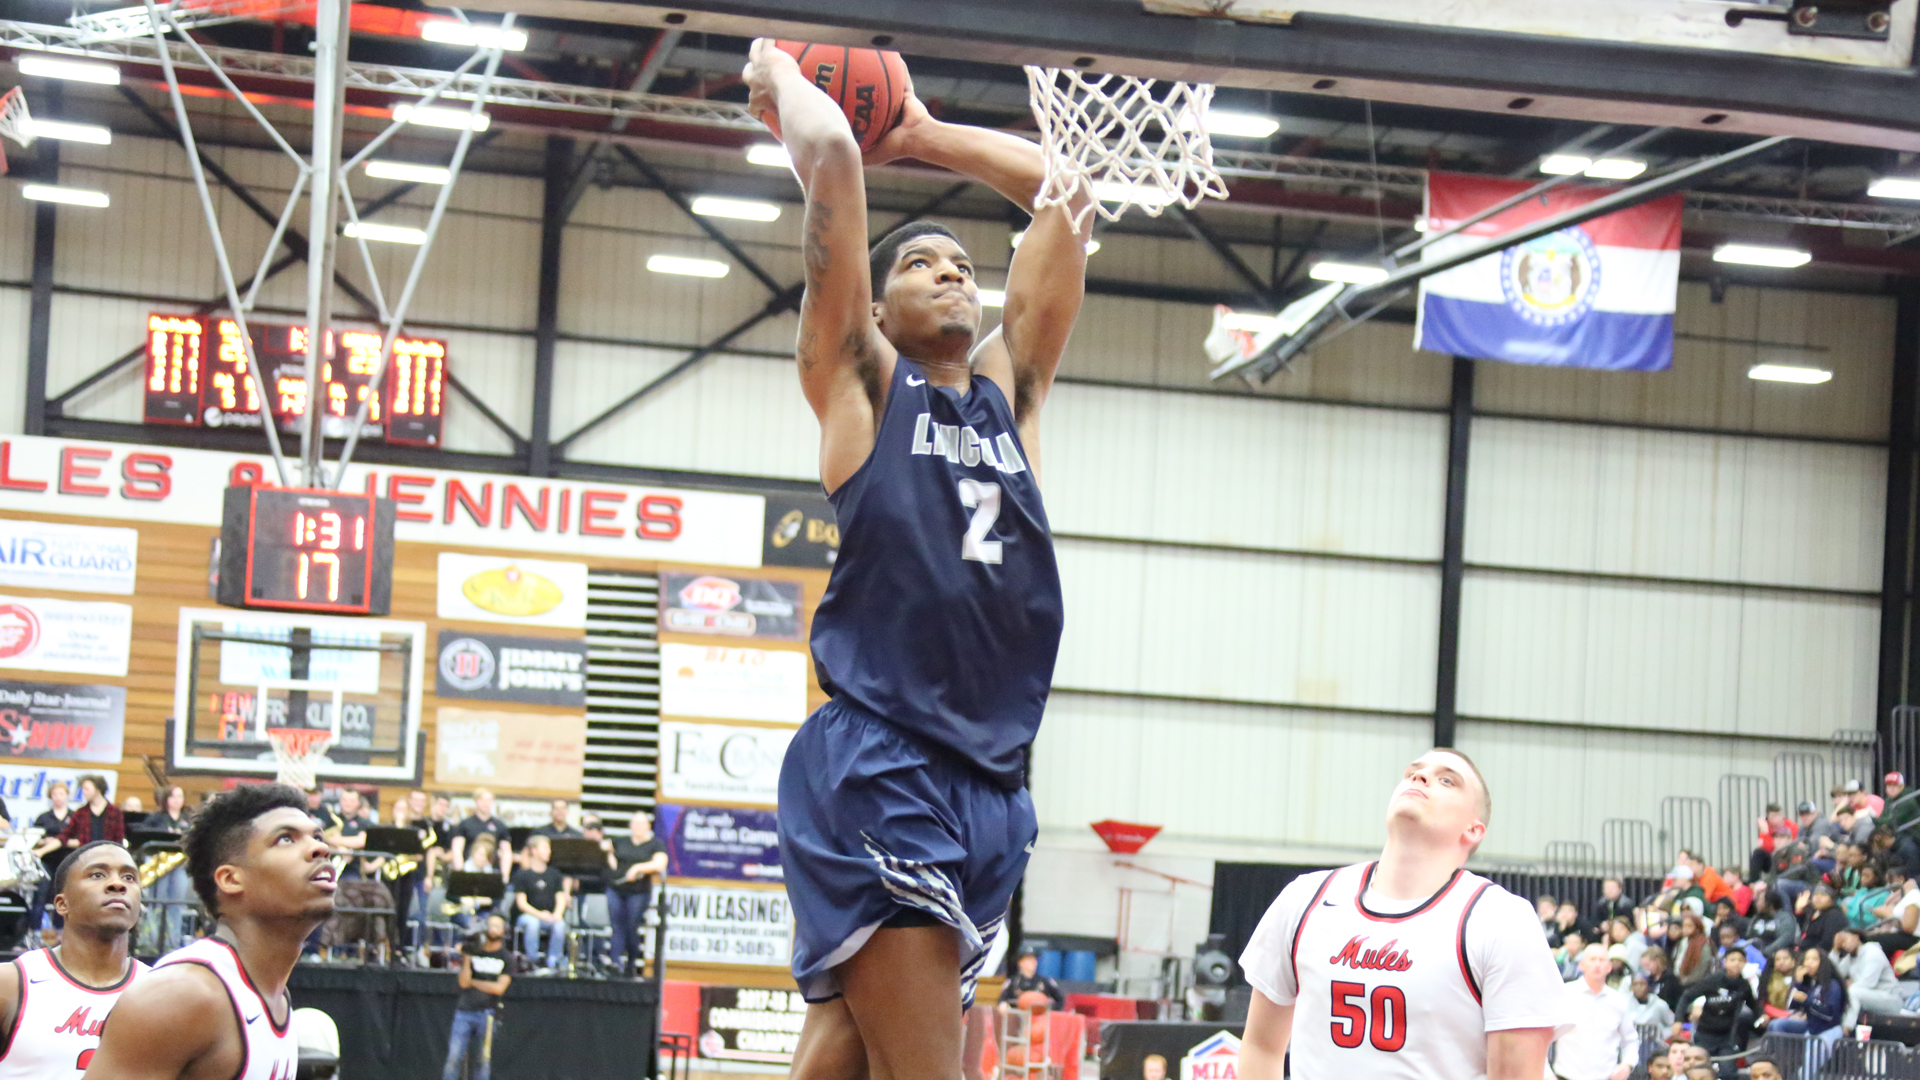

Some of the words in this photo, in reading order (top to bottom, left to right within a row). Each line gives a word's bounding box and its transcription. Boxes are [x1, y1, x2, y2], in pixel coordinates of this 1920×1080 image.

[293, 511, 365, 550] 1:31
[958, 478, 1003, 564] 2
[49, 551, 132, 571] GUARD
[298, 552, 341, 602] 17
[500, 648, 583, 671] JIMMY
[498, 669, 583, 692] JOHN'S
[659, 890, 700, 919] OW
[705, 893, 789, 925] LEASING!
[669, 937, 776, 957] 660-747-5085
[1329, 934, 1414, 972] Mules
[1329, 978, 1407, 1052] 50
